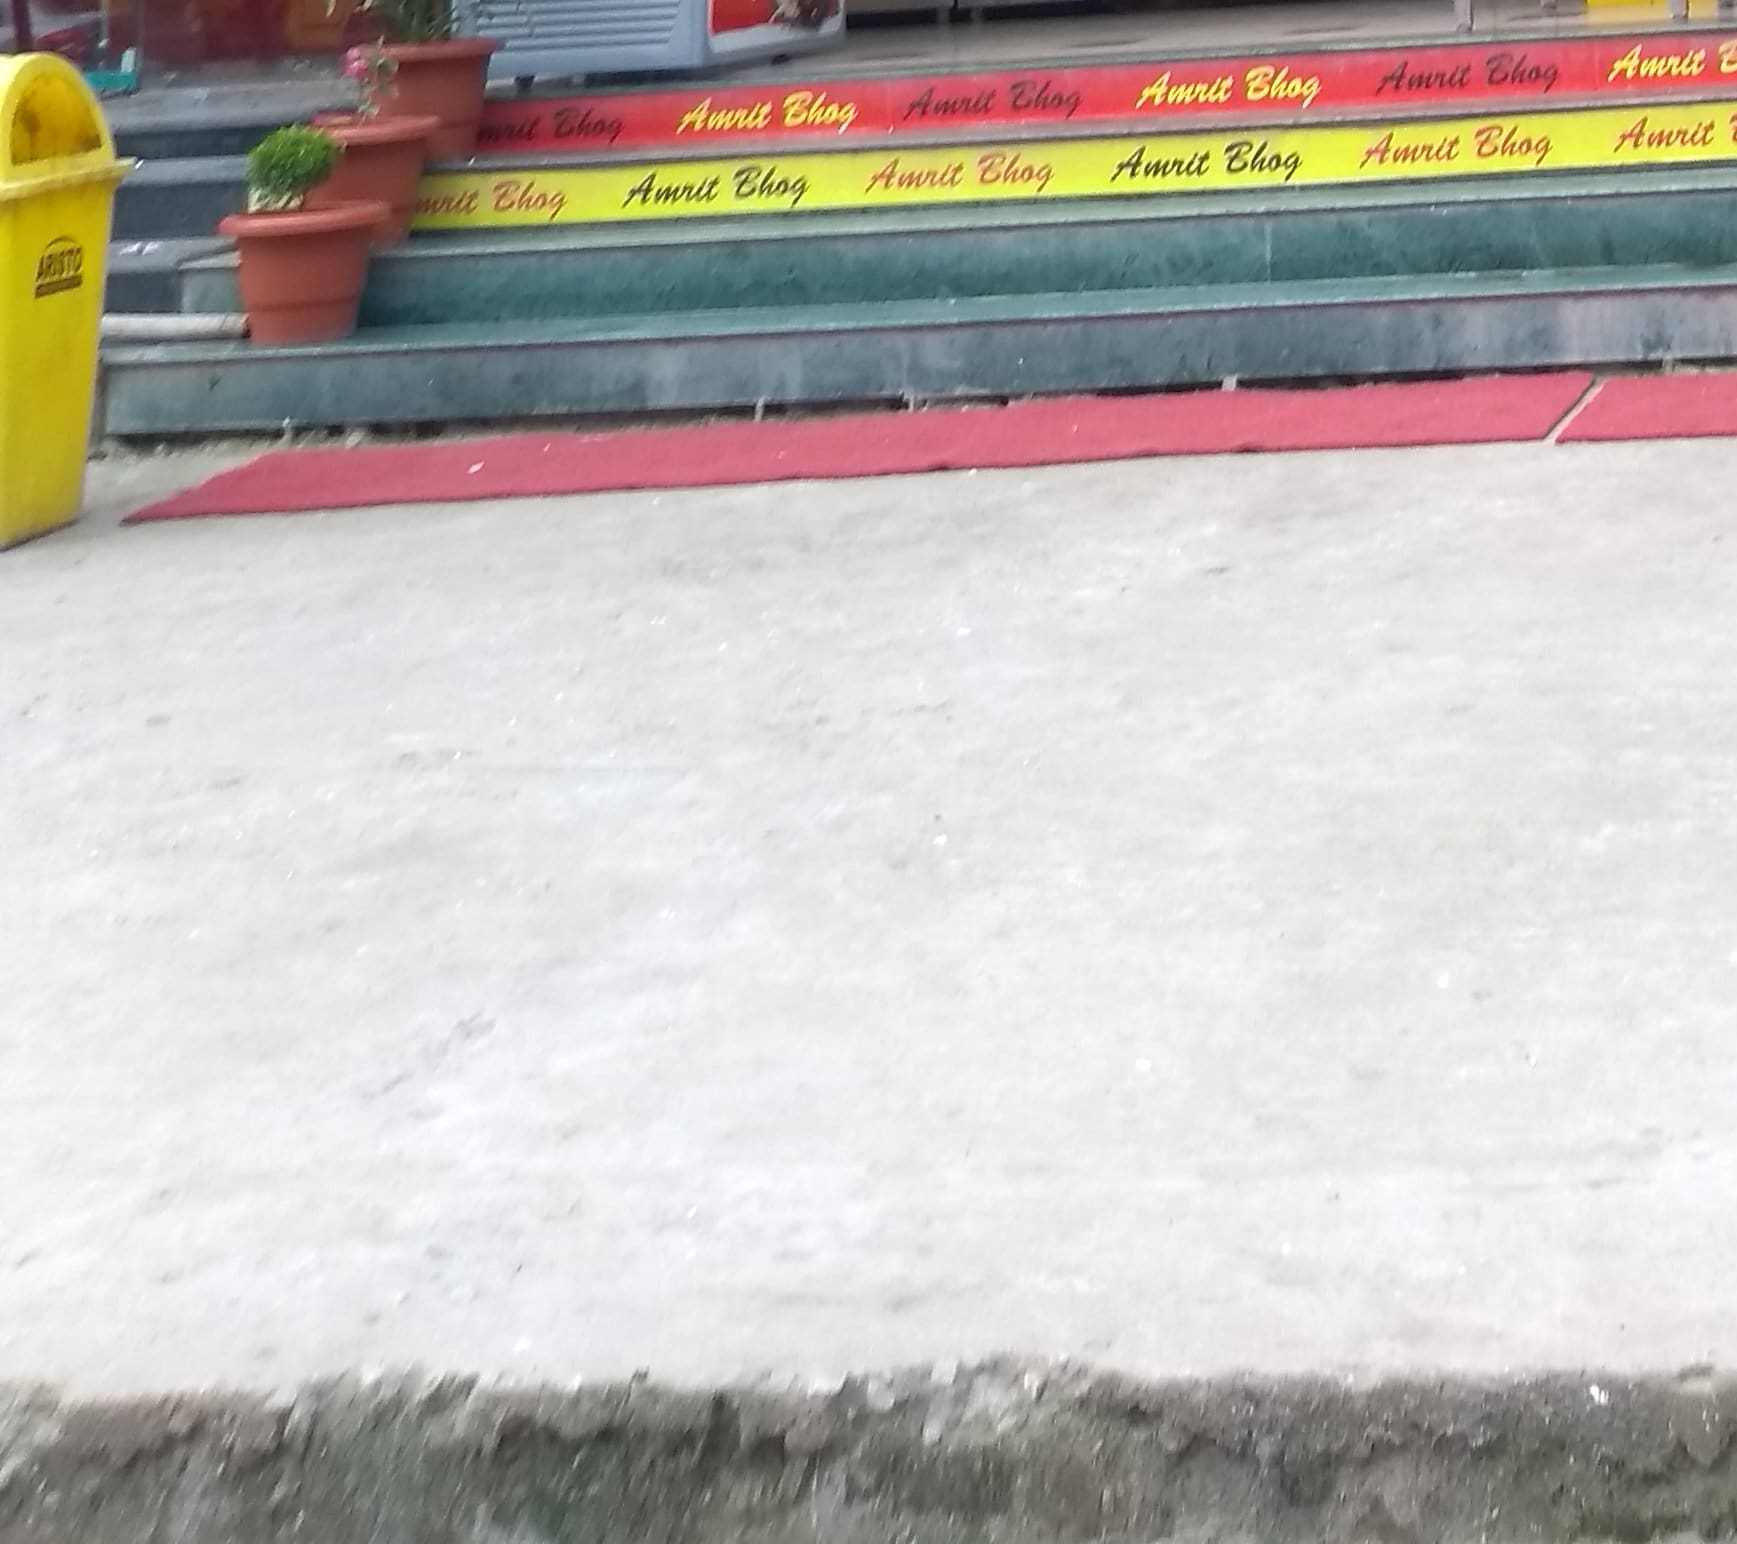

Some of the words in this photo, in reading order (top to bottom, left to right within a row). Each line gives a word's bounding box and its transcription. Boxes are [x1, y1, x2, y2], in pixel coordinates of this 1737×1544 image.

[478, 114, 537, 142] mrit
[552, 108, 624, 144] Bhog
[676, 97, 774, 135] Amrit
[782, 91, 858, 134] Bhog
[903, 85, 995, 120] Amrit
[1009, 80, 1084, 120] Bhog
[1135, 71, 1233, 109] Amrit
[1244, 65, 1323, 108] Bhog
[1375, 61, 1472, 94] Amrit
[1485, 54, 1559, 92] Bhog
[1606, 44, 1705, 80] Amrit
[416, 189, 479, 214] mrit
[491, 180, 568, 221] Bhog
[621, 170, 719, 209] Amrit
[732, 165, 811, 209] Bhog
[864, 156, 965, 195] Amrit
[977, 153, 1055, 195] Bhog
[1111, 146, 1211, 184] Amrit
[1224, 141, 1302, 184] Bhog
[1359, 131, 1460, 169] Amrit
[1474, 124, 1553, 168] Bhog
[1613, 115, 1714, 152] Amrit
